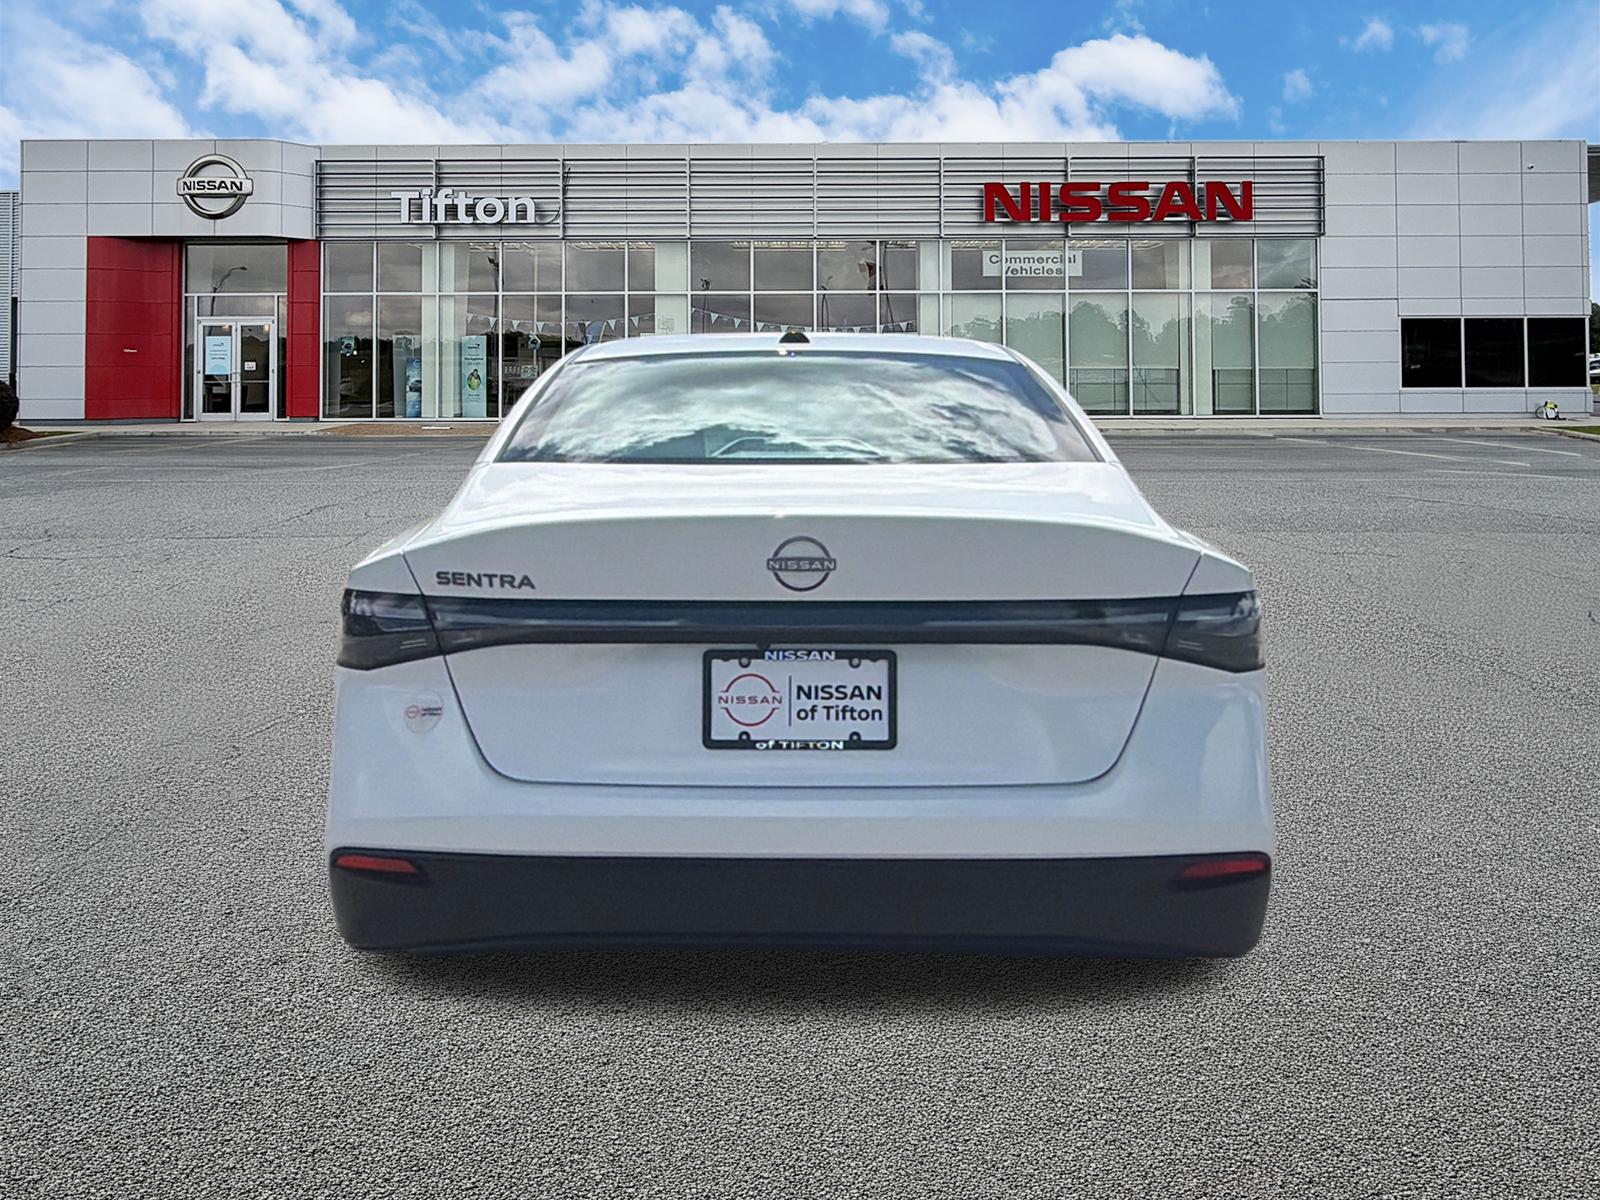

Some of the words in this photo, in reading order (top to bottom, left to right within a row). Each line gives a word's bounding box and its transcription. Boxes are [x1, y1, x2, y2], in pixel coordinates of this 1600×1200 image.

[182, 179, 243, 192] NISSAN
[391, 188, 536, 225] Tifton
[983, 180, 1254, 223] NISSAN
[768, 560, 835, 570] NISSAN
[436, 571, 536, 589] SENTRA
[764, 650, 836, 661] NISSAN
[718, 695, 783, 705] NISSAN
[796, 685, 882, 701] NISSAN
[796, 704, 818, 721] of
[822, 704, 883, 721] Tifton
[755, 740, 775, 750] of
[779, 741, 844, 750] TIFTON
